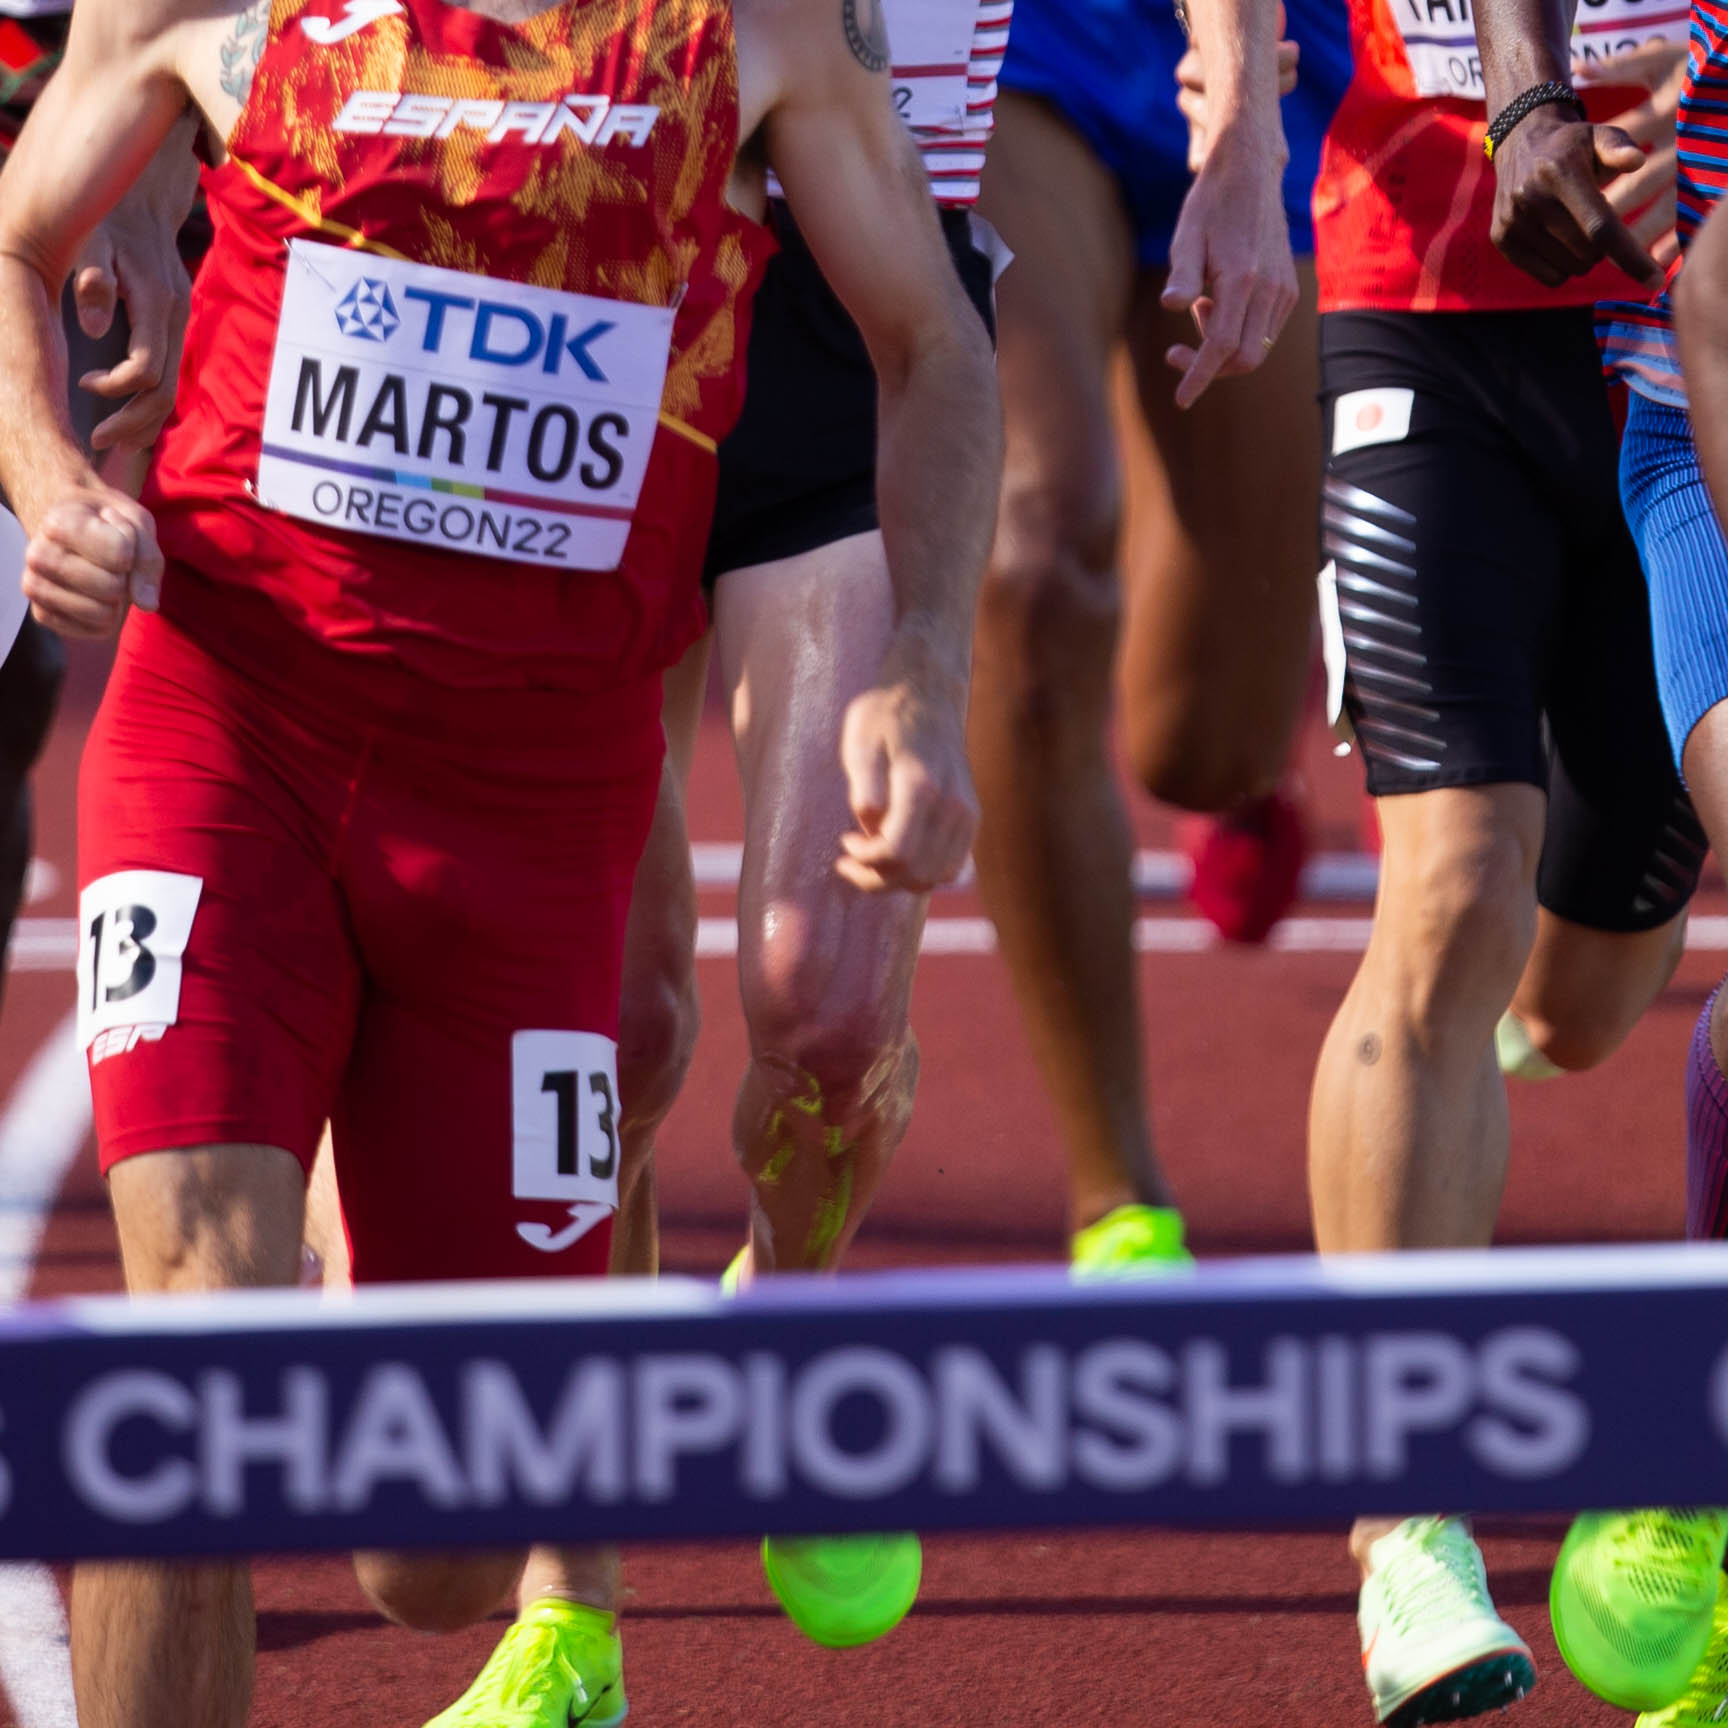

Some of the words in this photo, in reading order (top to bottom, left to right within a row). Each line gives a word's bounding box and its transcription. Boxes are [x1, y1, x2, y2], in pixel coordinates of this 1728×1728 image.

[403, 284, 619, 384] TDK
[290, 355, 631, 491] MARTOS
[312, 479, 573, 560] OREGON22
[89, 903, 158, 1014] 13
[540, 1070, 617, 1181] 13
[64, 1325, 1589, 1526] CHAMPIONSHIPS
